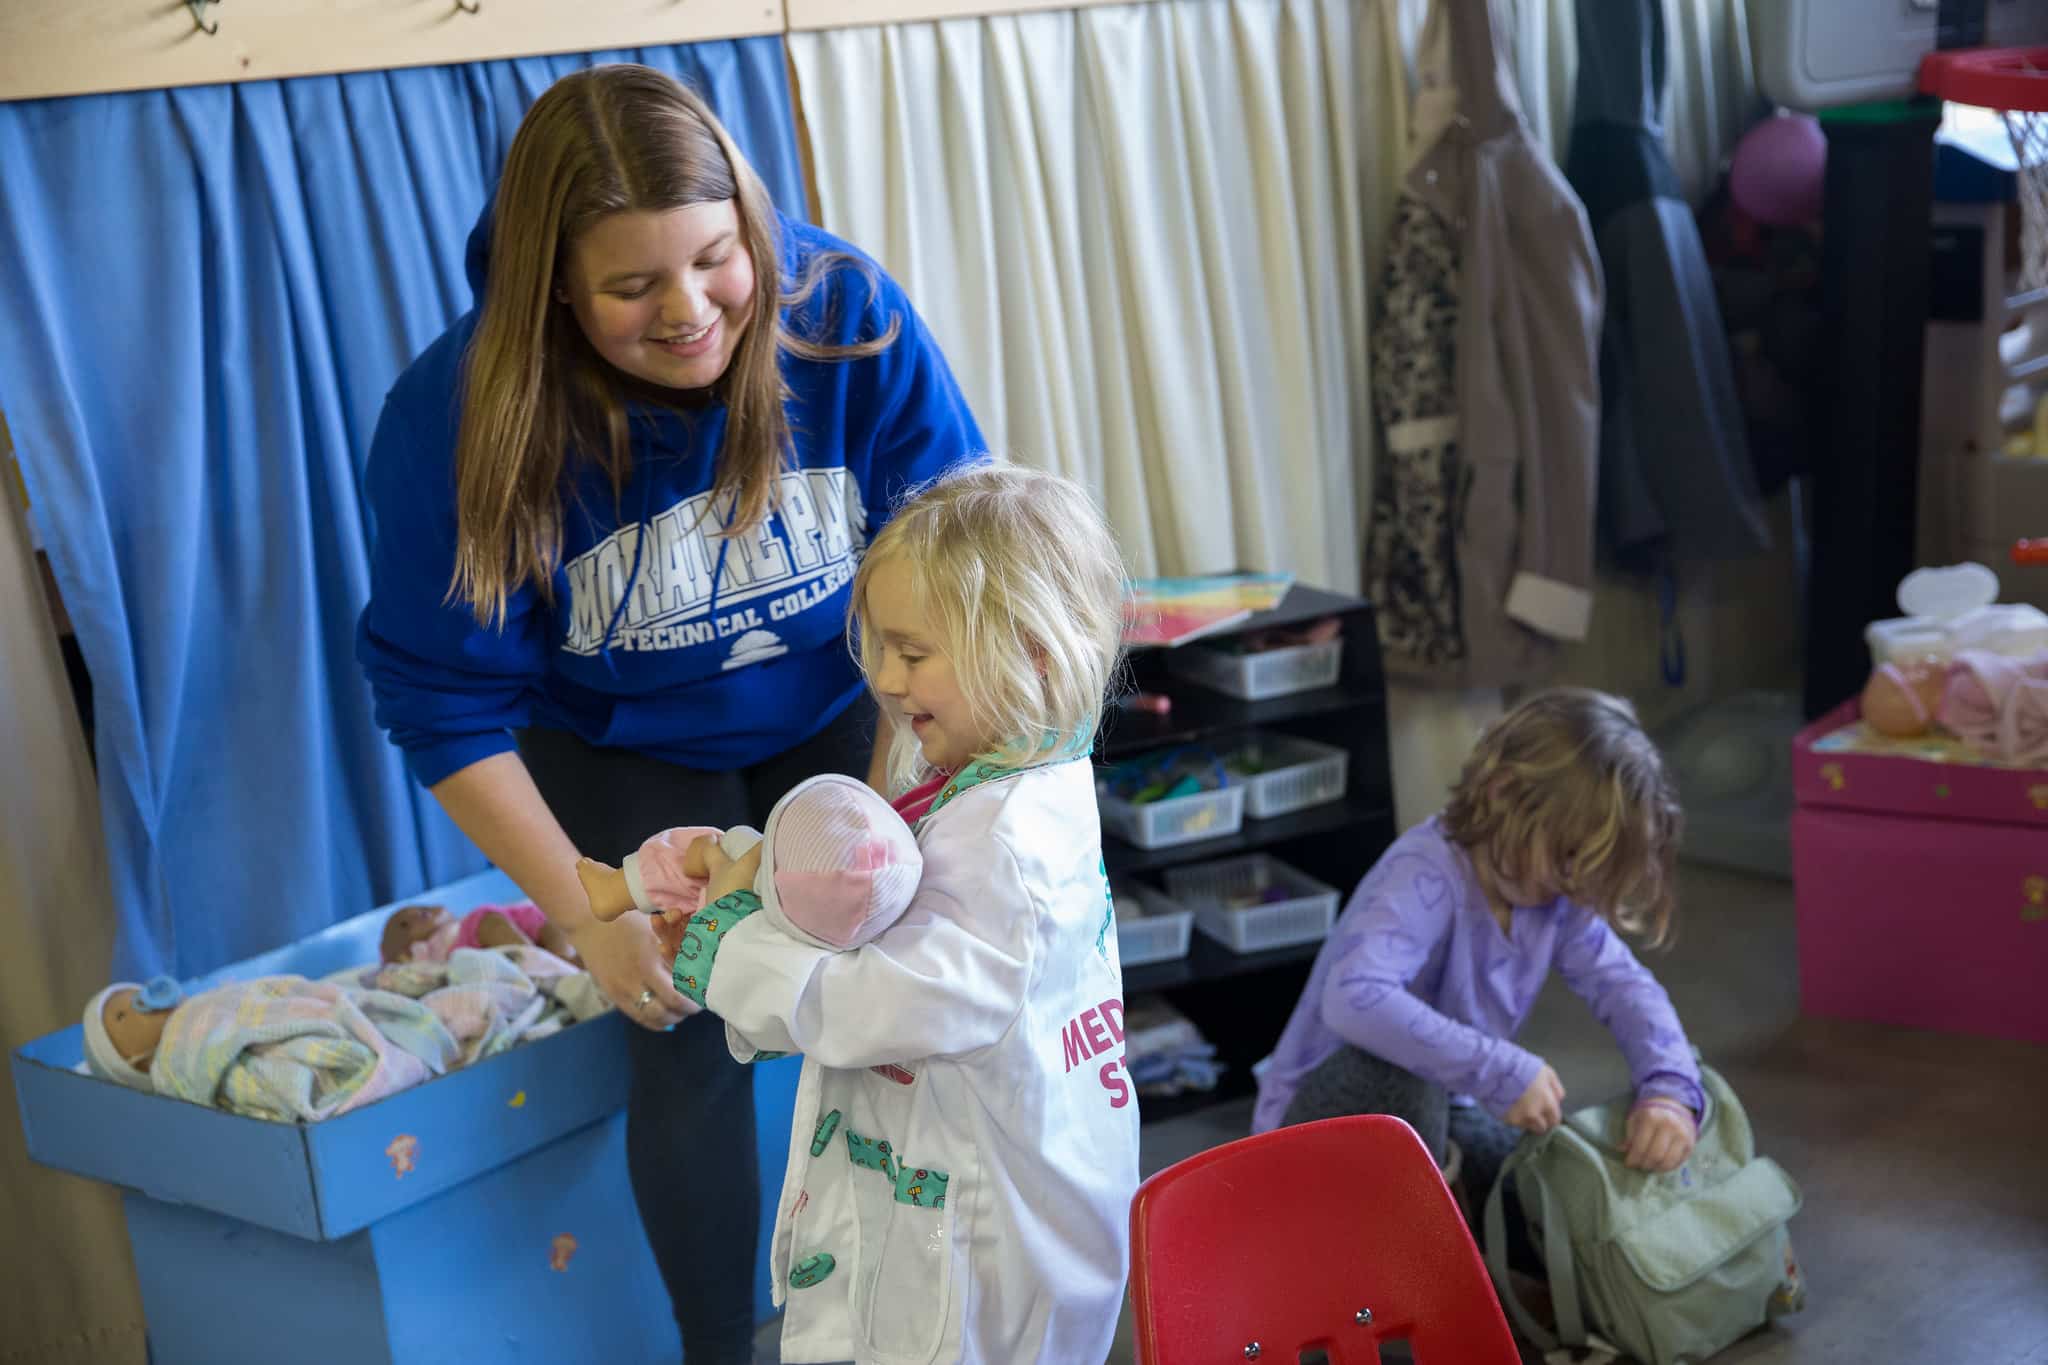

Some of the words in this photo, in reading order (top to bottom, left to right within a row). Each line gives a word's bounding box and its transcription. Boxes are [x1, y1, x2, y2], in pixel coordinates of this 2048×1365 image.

[774, 467, 865, 575] PA
[768, 561, 855, 621] COLLEG
[1099, 1055, 1129, 1109] S
